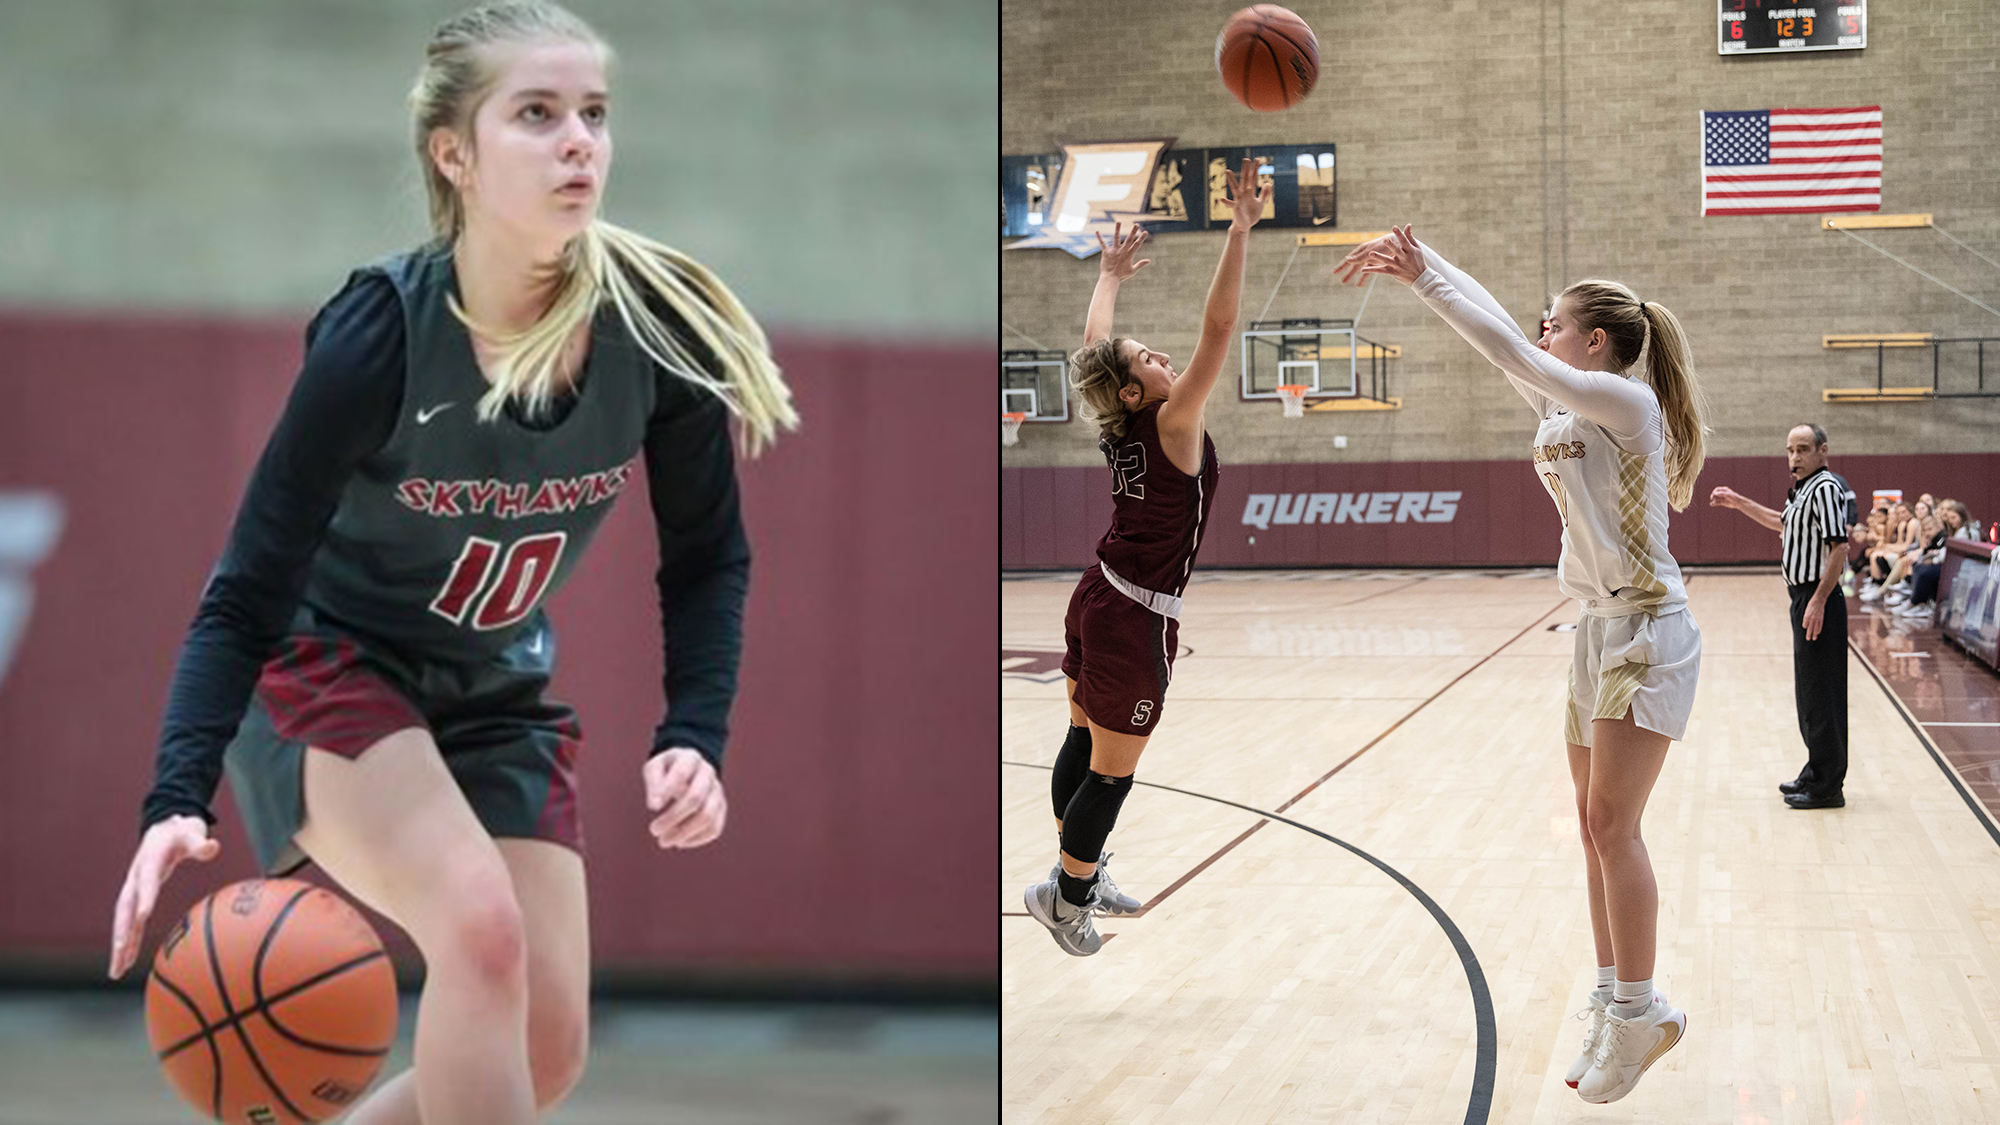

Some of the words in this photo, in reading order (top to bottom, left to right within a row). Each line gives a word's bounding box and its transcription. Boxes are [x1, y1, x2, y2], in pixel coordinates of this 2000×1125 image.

[1722, 11, 1747, 21] FOULS
[1768, 9, 1796, 19] PLAYER
[1797, 8, 1817, 18] FOUL
[1837, 5, 1862, 16] FOULS
[1731, 20, 1743, 39] 6
[1846, 15, 1859, 34] 5
[1242, 491, 1462, 530] QUAKERS
[428, 530, 567, 630] 10
[1131, 700, 1154, 726] S
